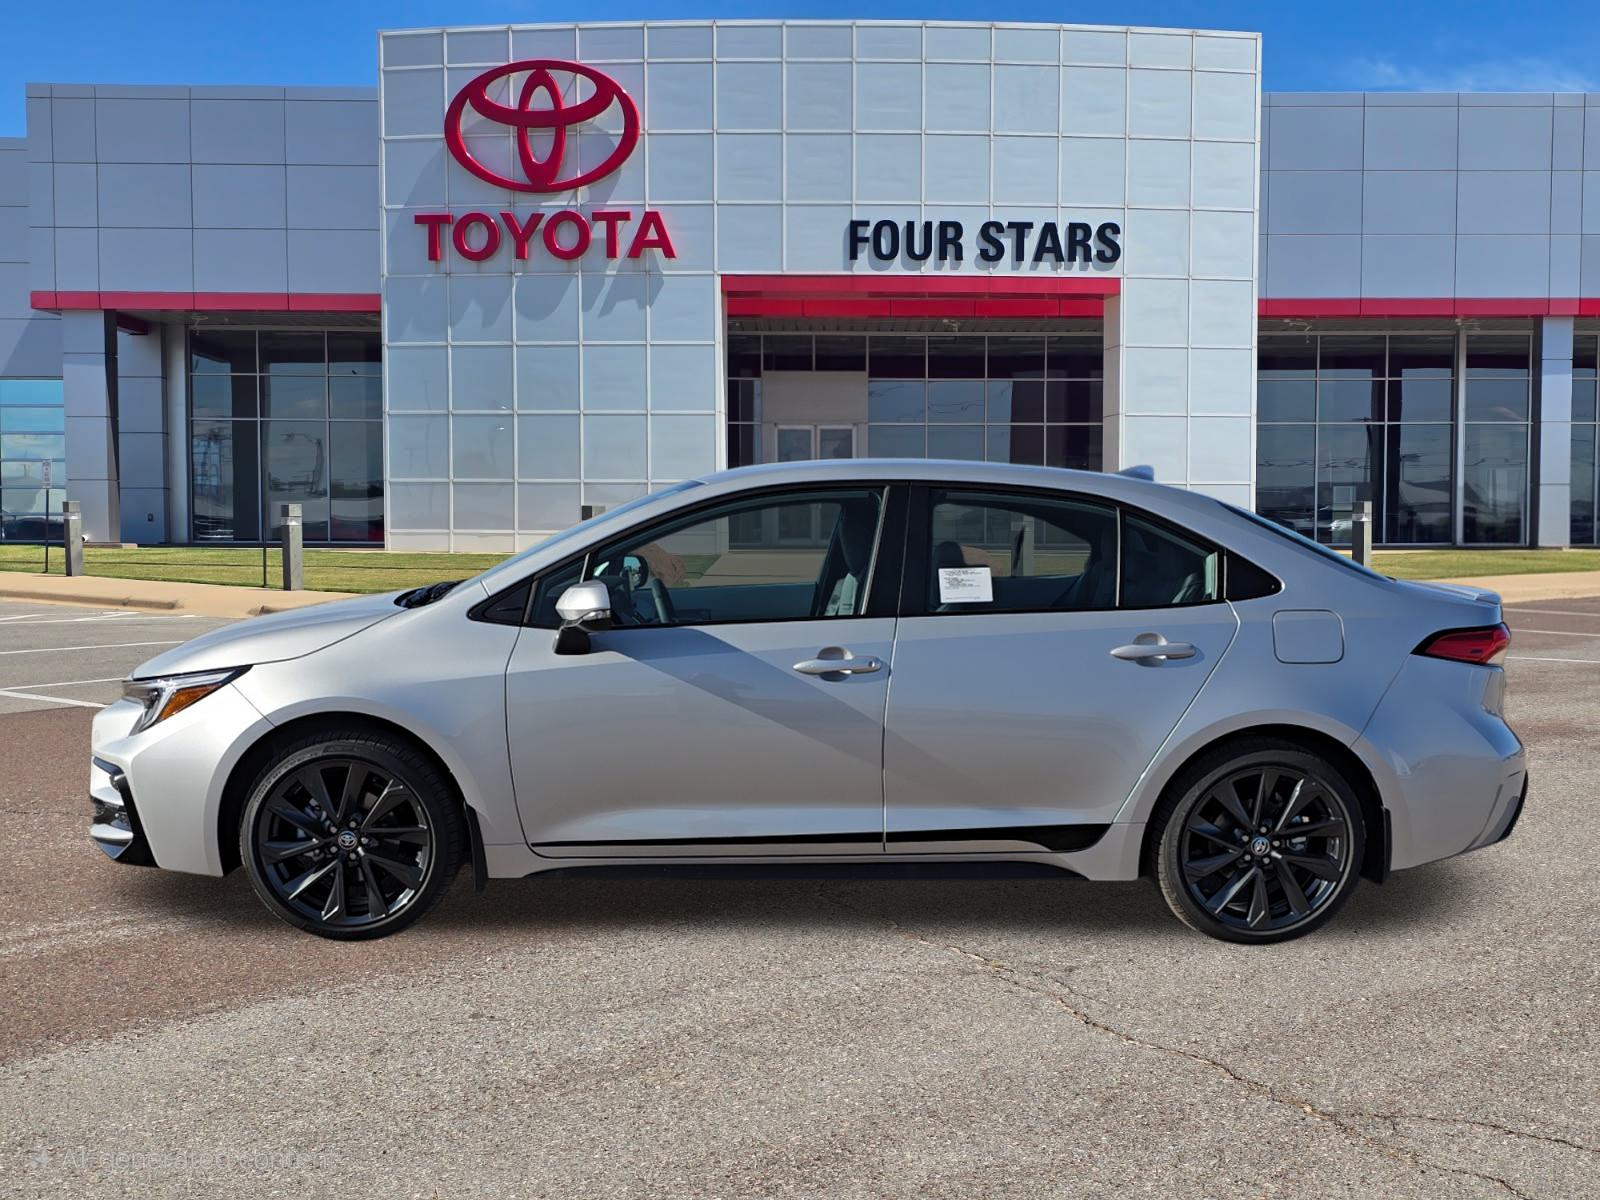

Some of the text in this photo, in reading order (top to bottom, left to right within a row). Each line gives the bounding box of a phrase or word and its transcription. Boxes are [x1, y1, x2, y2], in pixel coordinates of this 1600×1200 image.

[414, 210, 676, 261] TOYOTA
[849, 219, 1121, 264] FOUR STARS
